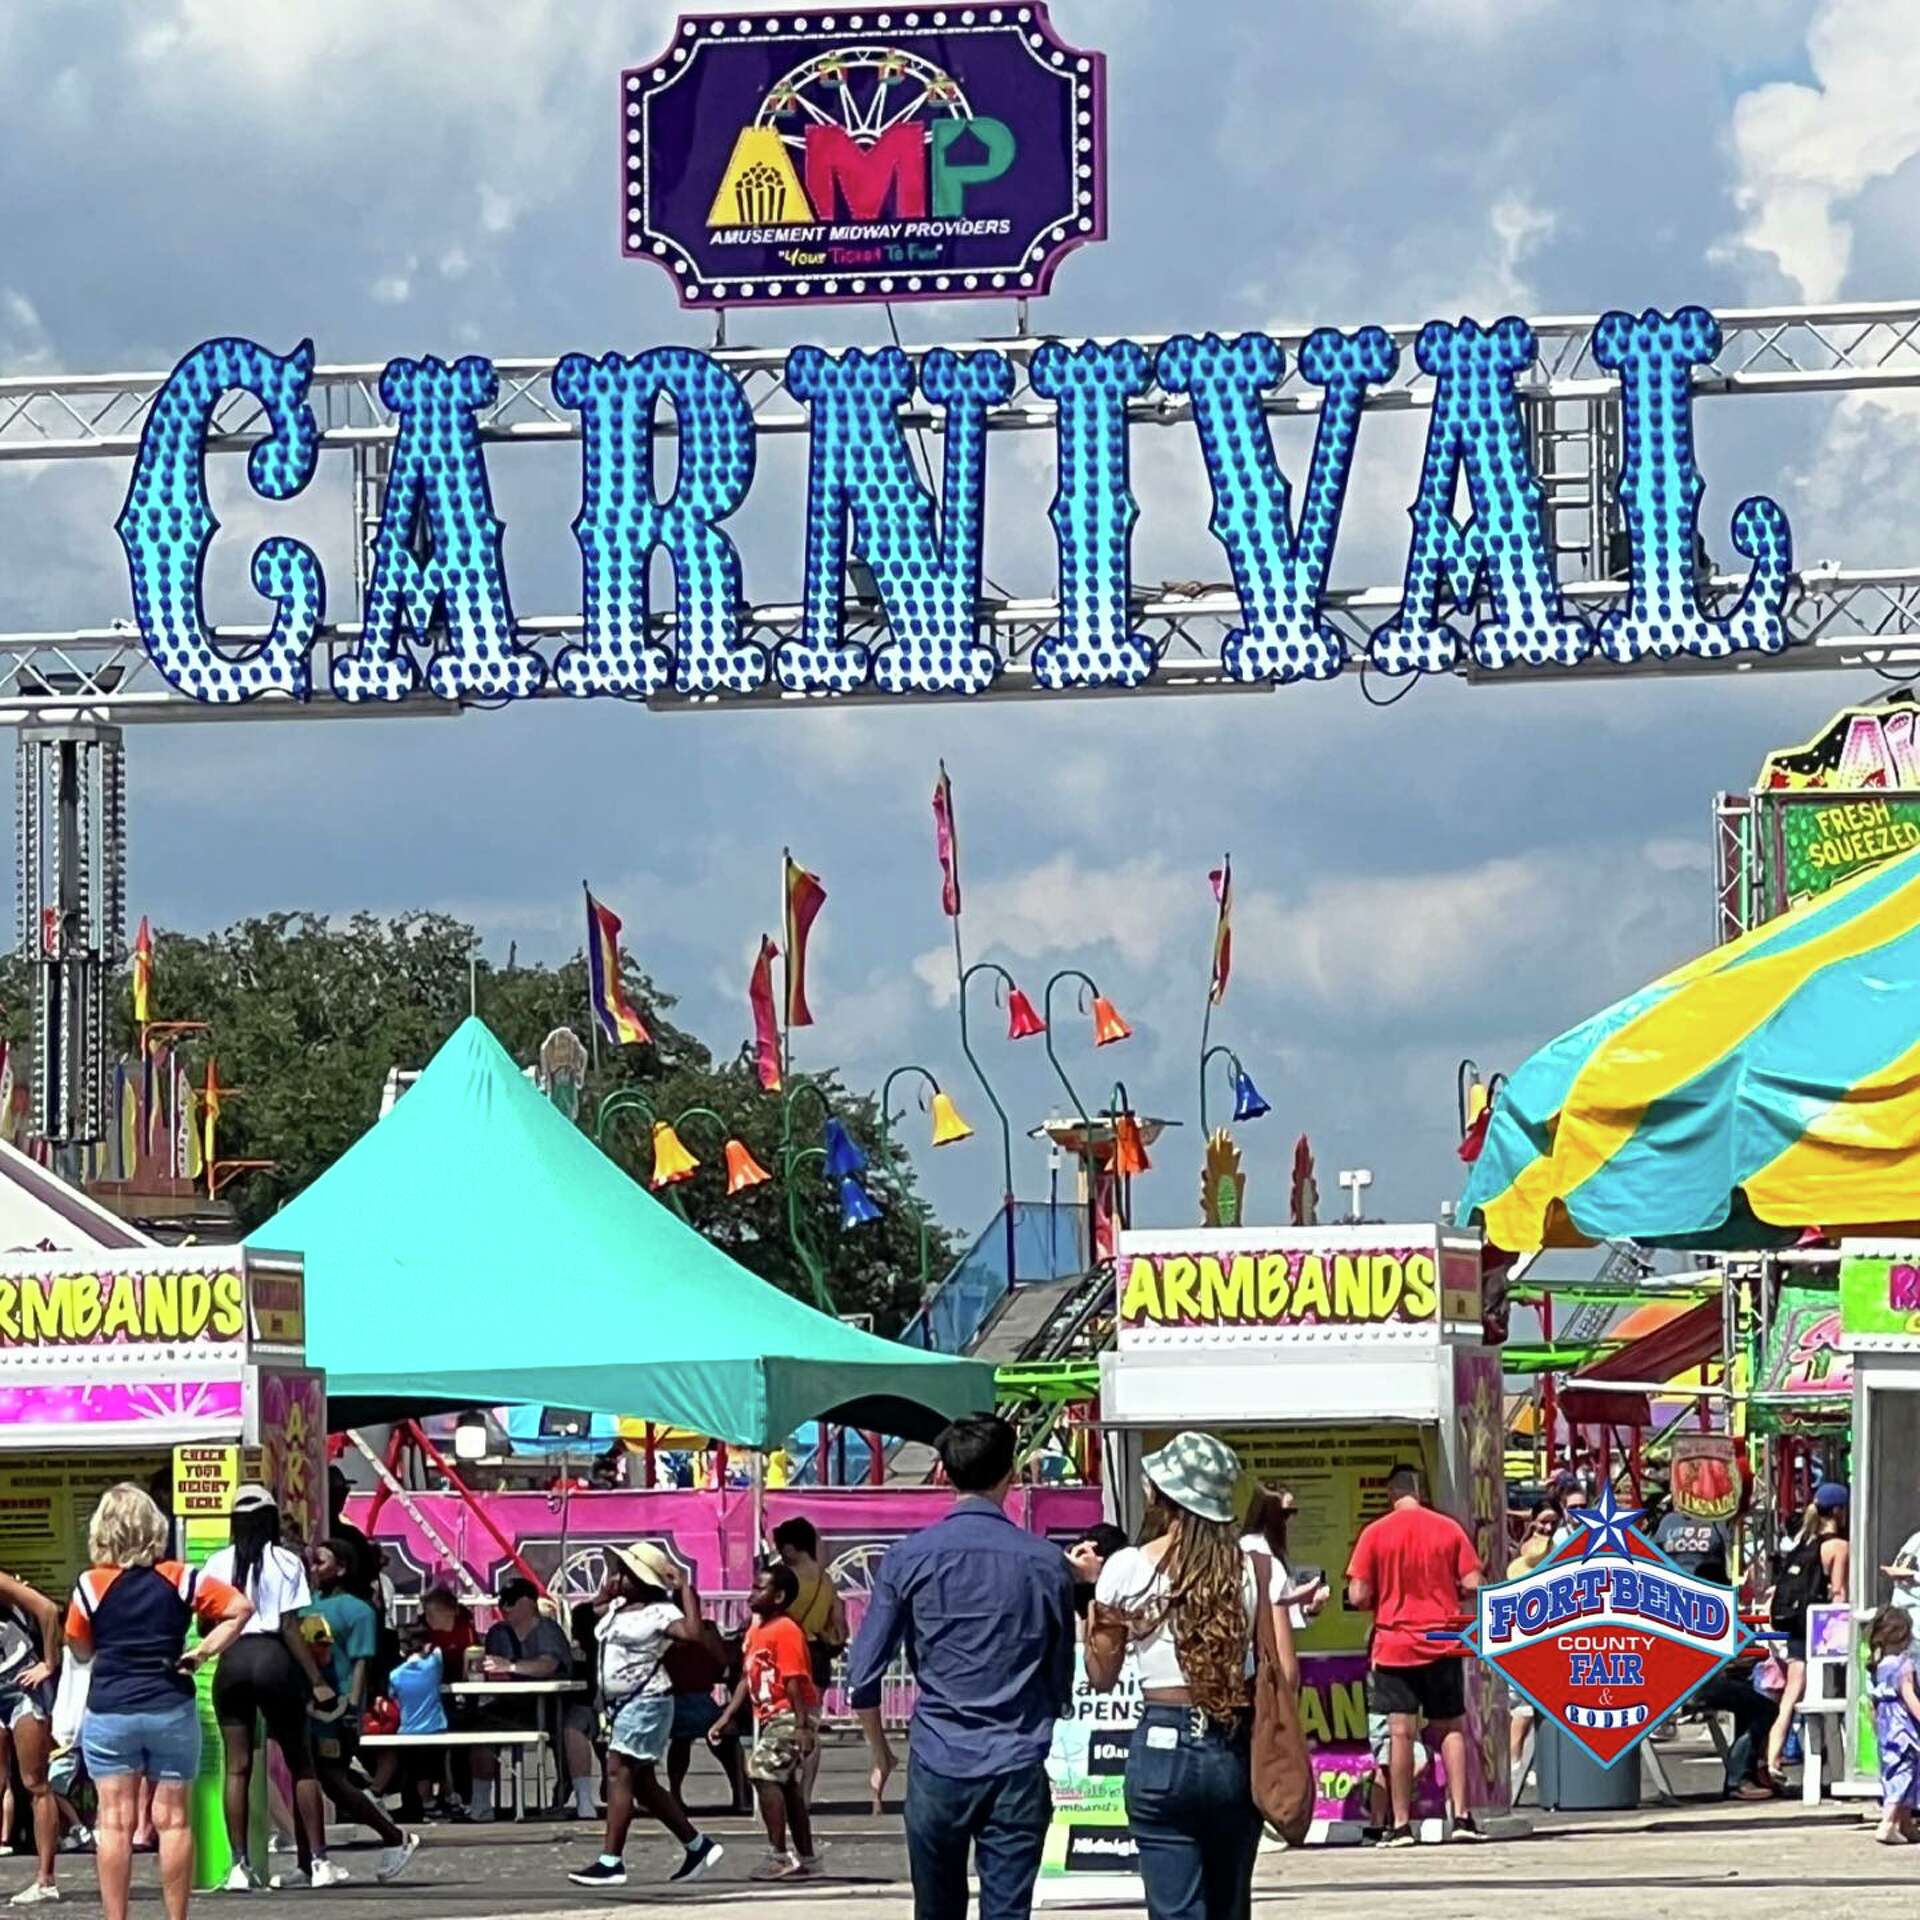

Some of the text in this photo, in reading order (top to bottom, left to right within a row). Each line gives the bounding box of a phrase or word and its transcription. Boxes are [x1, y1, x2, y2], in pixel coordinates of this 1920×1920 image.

[706, 117, 1016, 226] AMP
[709, 219, 1011, 245] AMUSEMENT MIDWAY PROVIDERS
[116, 305, 1792, 705] CARNIVAL
[1808, 821, 1920, 869] SQUEEZED
[1815, 798, 1891, 838] FRESH
[1121, 1253, 1438, 1322] ARMBANDS
